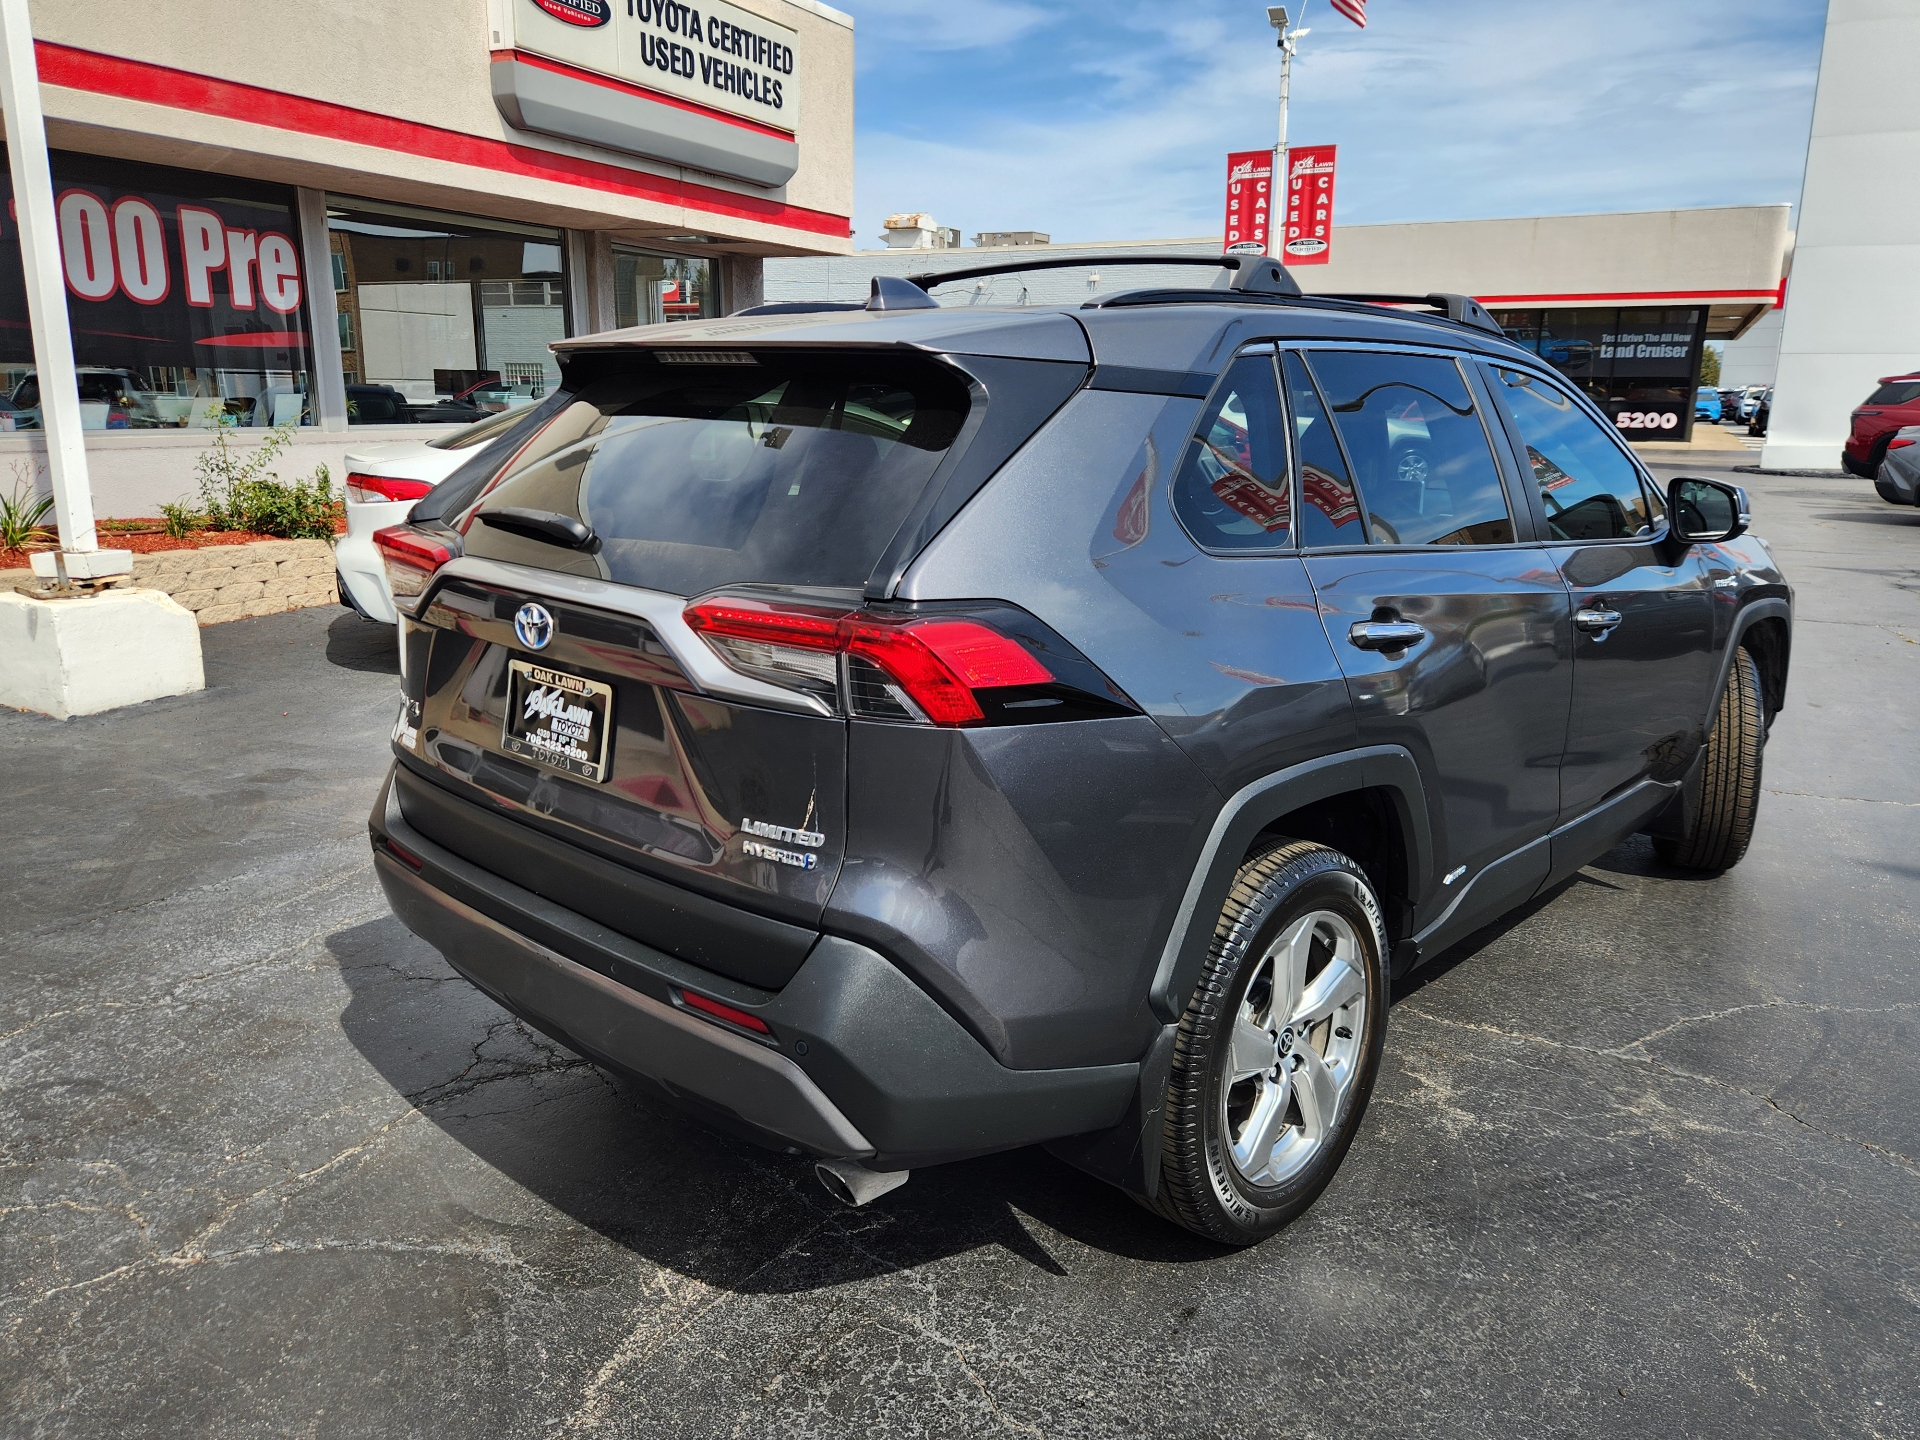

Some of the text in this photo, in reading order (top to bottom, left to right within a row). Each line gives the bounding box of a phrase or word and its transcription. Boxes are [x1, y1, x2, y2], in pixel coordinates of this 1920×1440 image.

[708, 15, 793, 75] CERTIFIED
[640, 31, 783, 109] USED VEHICLES
[1229, 183, 1241, 242] USED
[1254, 181, 1267, 240] CARS
[1289, 178, 1302, 238] USED
[1315, 177, 1329, 236] CARS
[176, 204, 303, 314] Pre
[1600, 343, 1689, 359] Land Cruiser
[1622, 333, 1644, 343] Drive
[1645, 333, 1660, 342] The
[1660, 333, 1673, 342] All
[1673, 333, 1692, 342] New
[1615, 411, 1678, 429] 5200
[533, 668, 584, 692] OAK LAWN
[536, 727, 551, 739] 4320
[551, 731, 559, 741] W
[556, 719, 585, 738] TOYOTA
[525, 731, 588, 760] 708-423-5200
[531, 746, 571, 770] TOYOTA
[740, 817, 826, 848] LIMITED
[742, 840, 805, 869] HYBRID
[1210, 1143, 1245, 1218] MICHELIN
